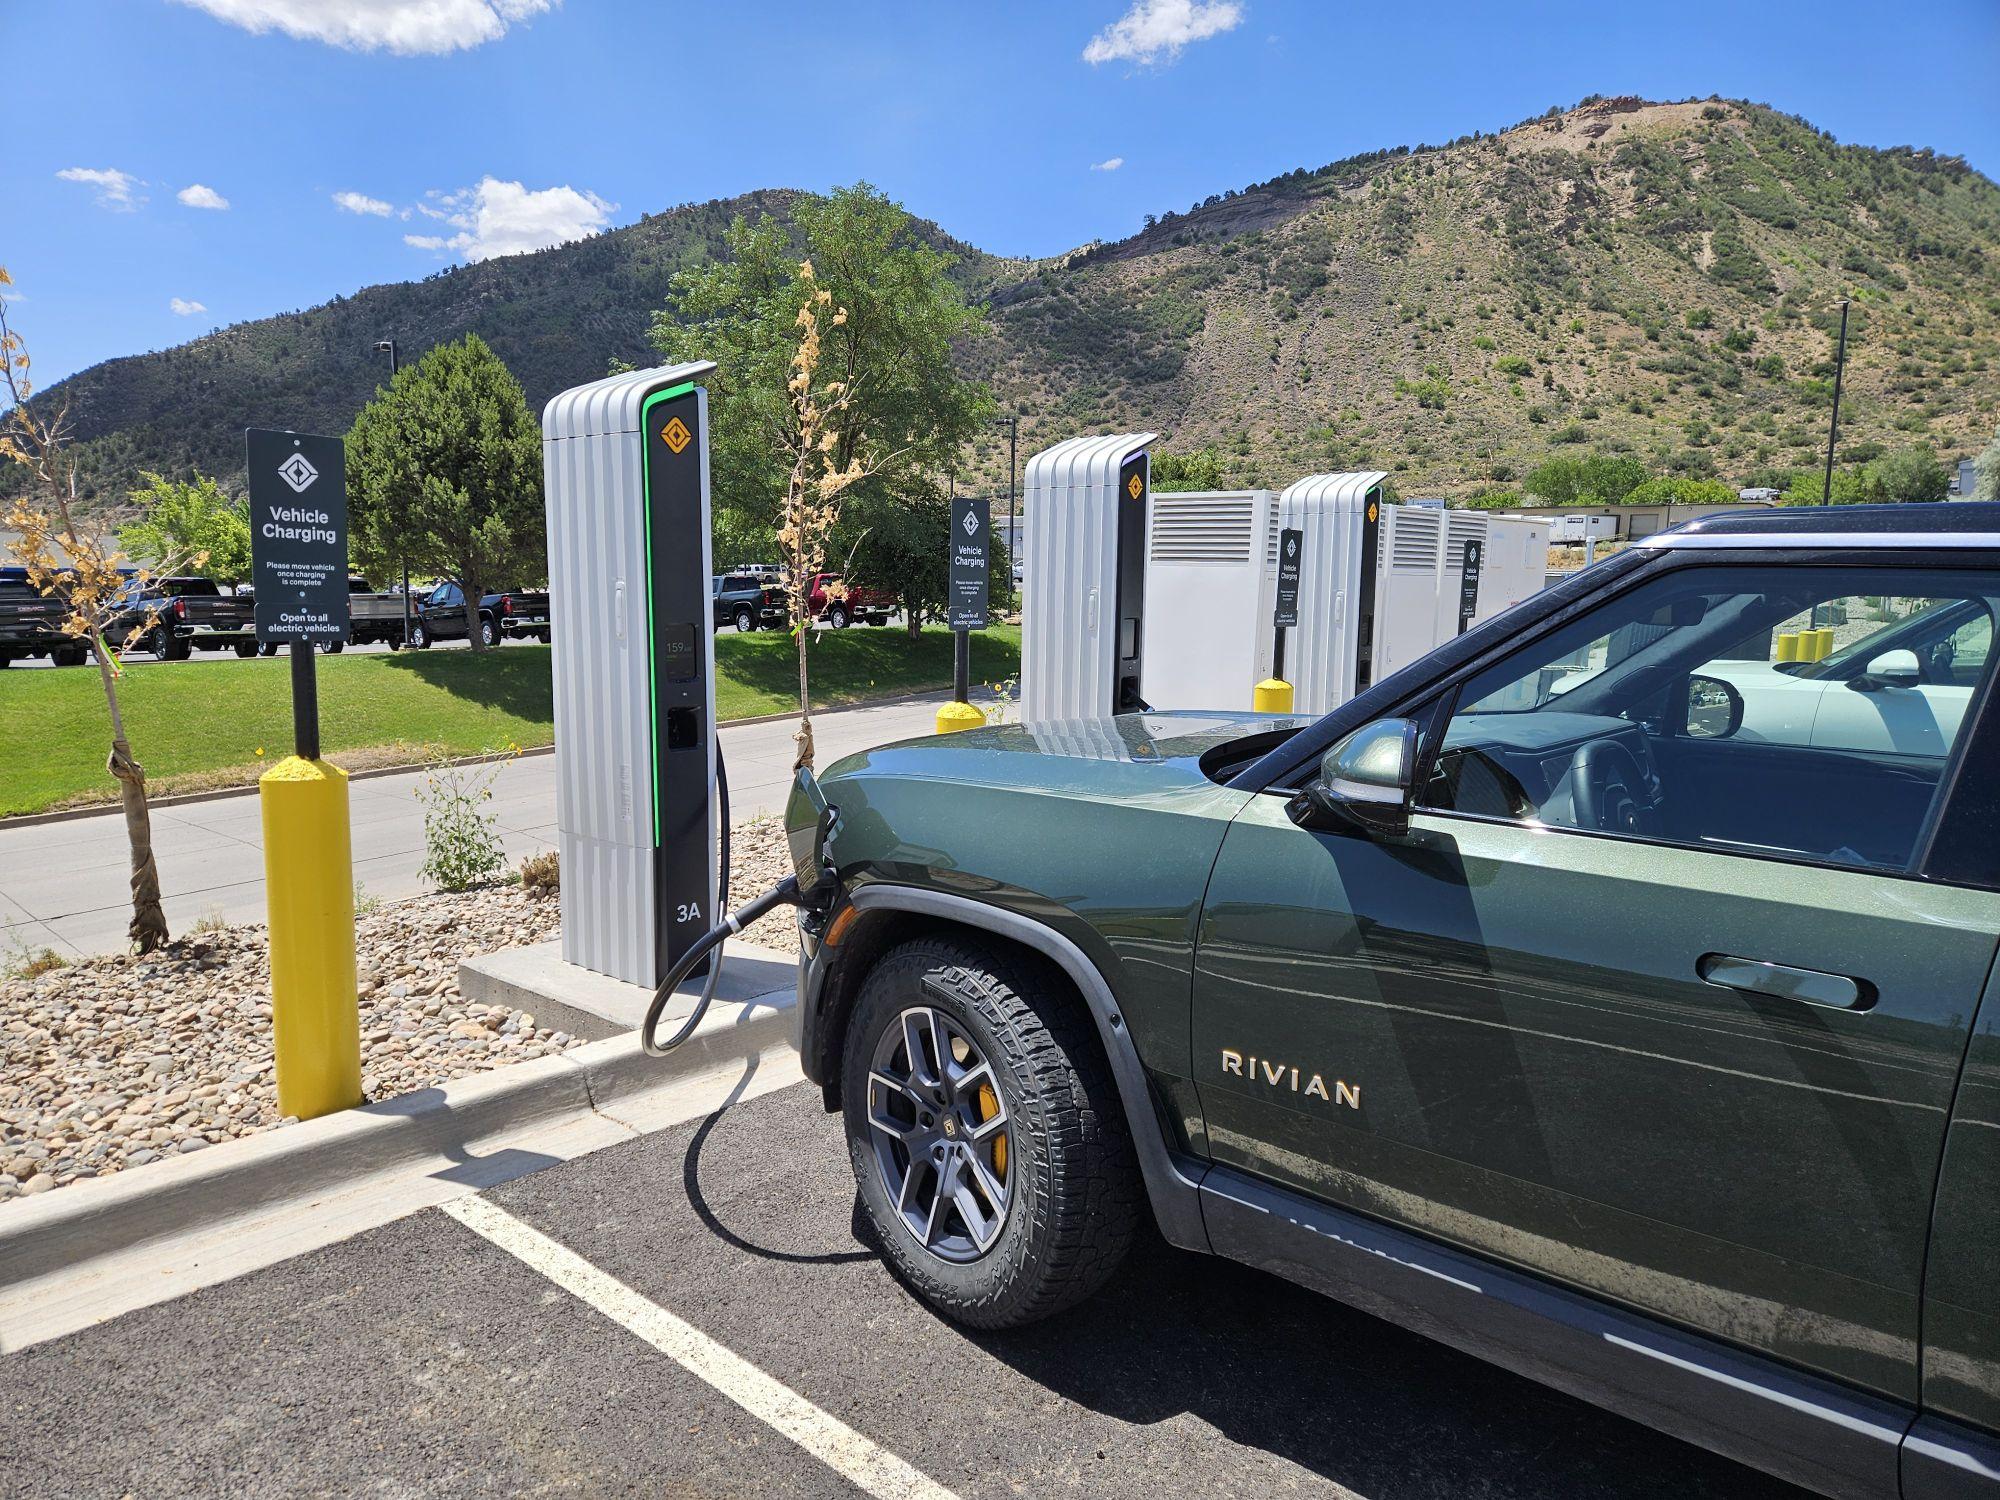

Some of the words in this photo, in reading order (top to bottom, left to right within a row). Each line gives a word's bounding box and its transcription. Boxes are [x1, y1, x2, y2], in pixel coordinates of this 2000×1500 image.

[269, 506, 329, 524] Vehicle
[262, 523, 336, 544] Charging
[958, 545, 982, 555] Vehicle
[266, 561, 290, 570] Please
[291, 563, 310, 571] move
[310, 563, 335, 571] vehicle
[954, 556, 985, 568] Charging
[277, 570, 295, 578] once
[295, 570, 326, 579] charging
[281, 577, 288, 585] is
[289, 578, 322, 586] complete
[280, 613, 305, 624] Open
[306, 614, 316, 622] to
[317, 613, 328, 622] all
[268, 623, 303, 633] electric
[304, 624, 340, 633] vehicles
[666, 642, 684, 653] 159
[676, 902, 701, 923] 3A
[1222, 1049, 1361, 1110] RIVIAN
